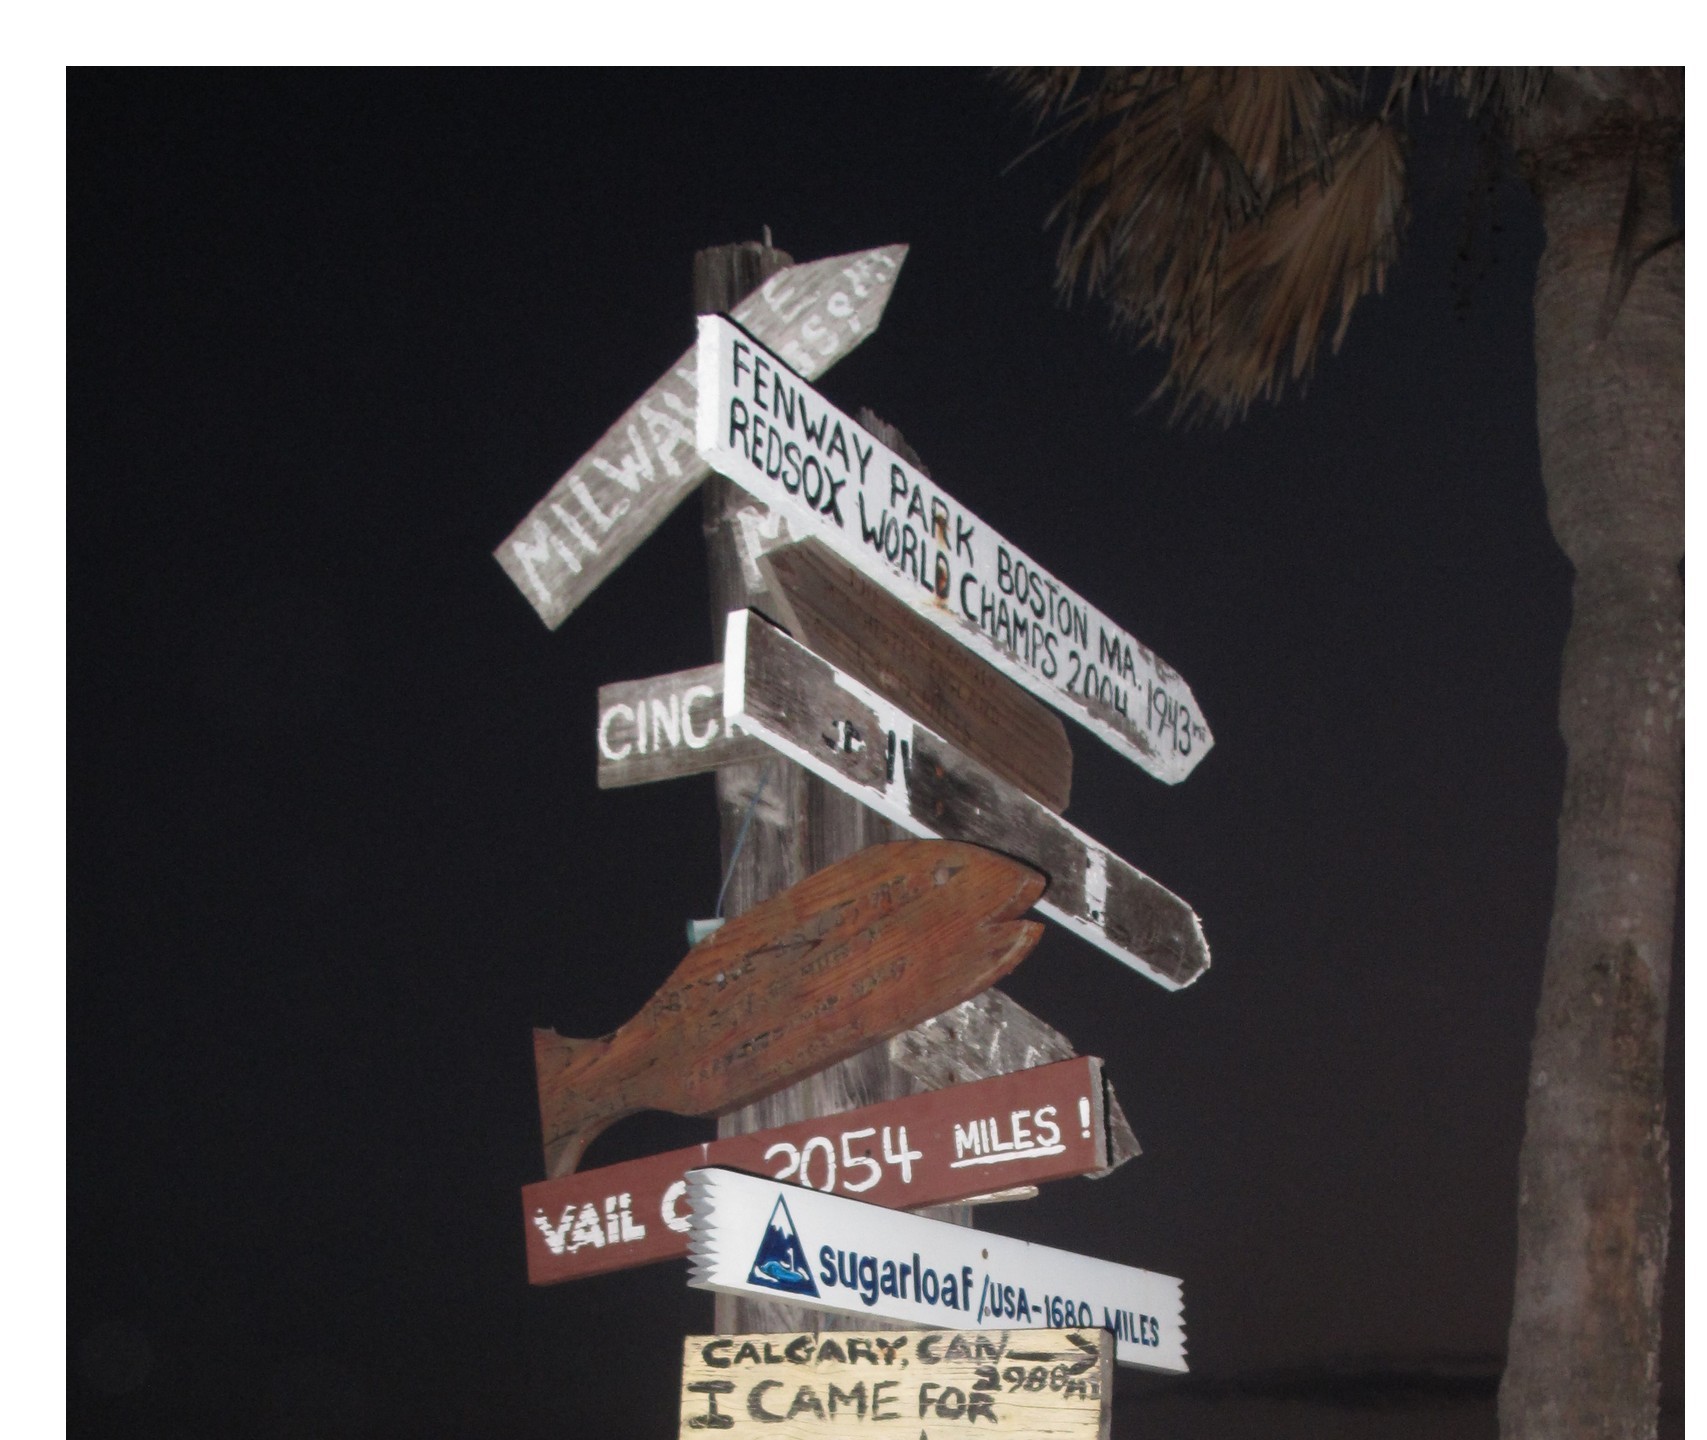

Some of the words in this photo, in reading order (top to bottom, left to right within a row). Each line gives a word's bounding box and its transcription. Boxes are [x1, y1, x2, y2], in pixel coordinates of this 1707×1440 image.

[730, 398, 845, 526] REDSOX
[856, 495, 949, 599] WORLD
[959, 570, 1058, 680] CHAMPS
[1066, 650, 1130, 719] 2004
[732, 341, 872, 483] FENWAY
[891, 463, 975, 569] PARK
[998, 545, 1087, 652] BOSTON
[533, 1194, 645, 1254] VAIL
[765, 1125, 921, 1193] 2054
[954, 1105, 1062, 1160] MILES
[702, 1335, 908, 1368] CALGARY,
[915, 1332, 1009, 1365] CAN
[819, 1243, 973, 1313] sugarloaf
[1104, 1306, 1160, 1348] MILES
[687, 1380, 735, 1430] I
[747, 1379, 900, 1424] CAME
[919, 1382, 999, 1424] FOR
